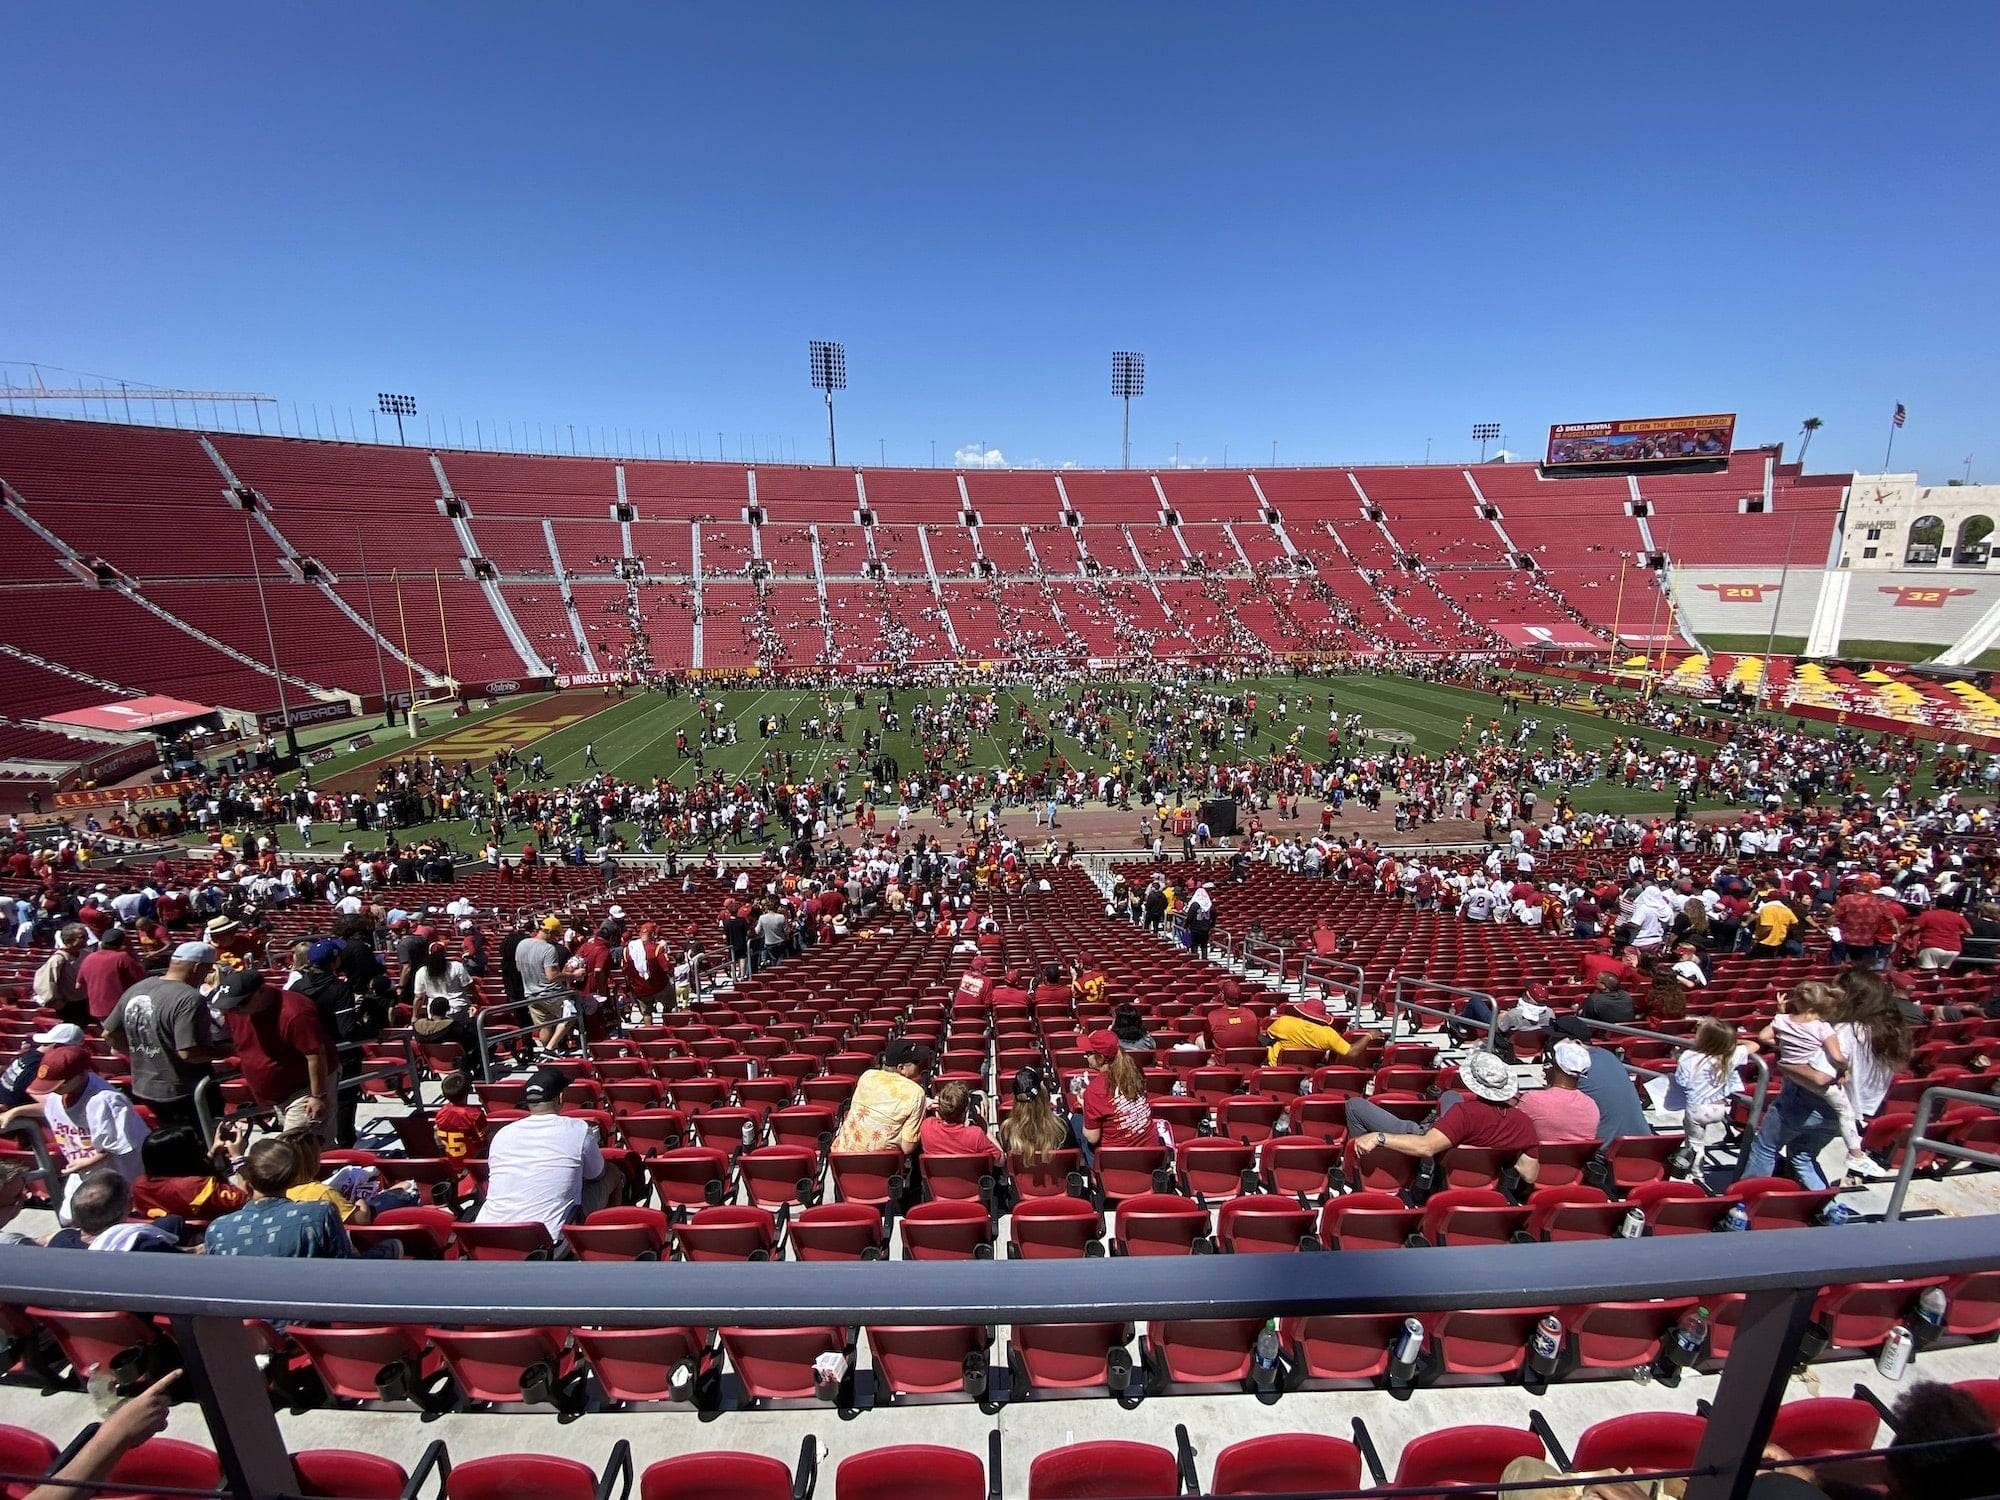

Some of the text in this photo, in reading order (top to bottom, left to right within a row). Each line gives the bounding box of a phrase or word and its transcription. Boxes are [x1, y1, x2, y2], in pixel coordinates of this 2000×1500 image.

[1586, 423, 1612, 431] DENTAL
[1670, 420, 1694, 428] VIDEO
[1726, 588, 1754, 597] 20
[1906, 591, 1940, 601] 32
[572, 673, 608, 685] MUSCLE
[490, 681, 516, 693] Ralphs
[266, 703, 347, 727] POWERADE
[1477, 896, 1486, 908] 2
[1083, 975, 1105, 1002] 37
[1884, 1346, 1899, 1371] ULTRA
